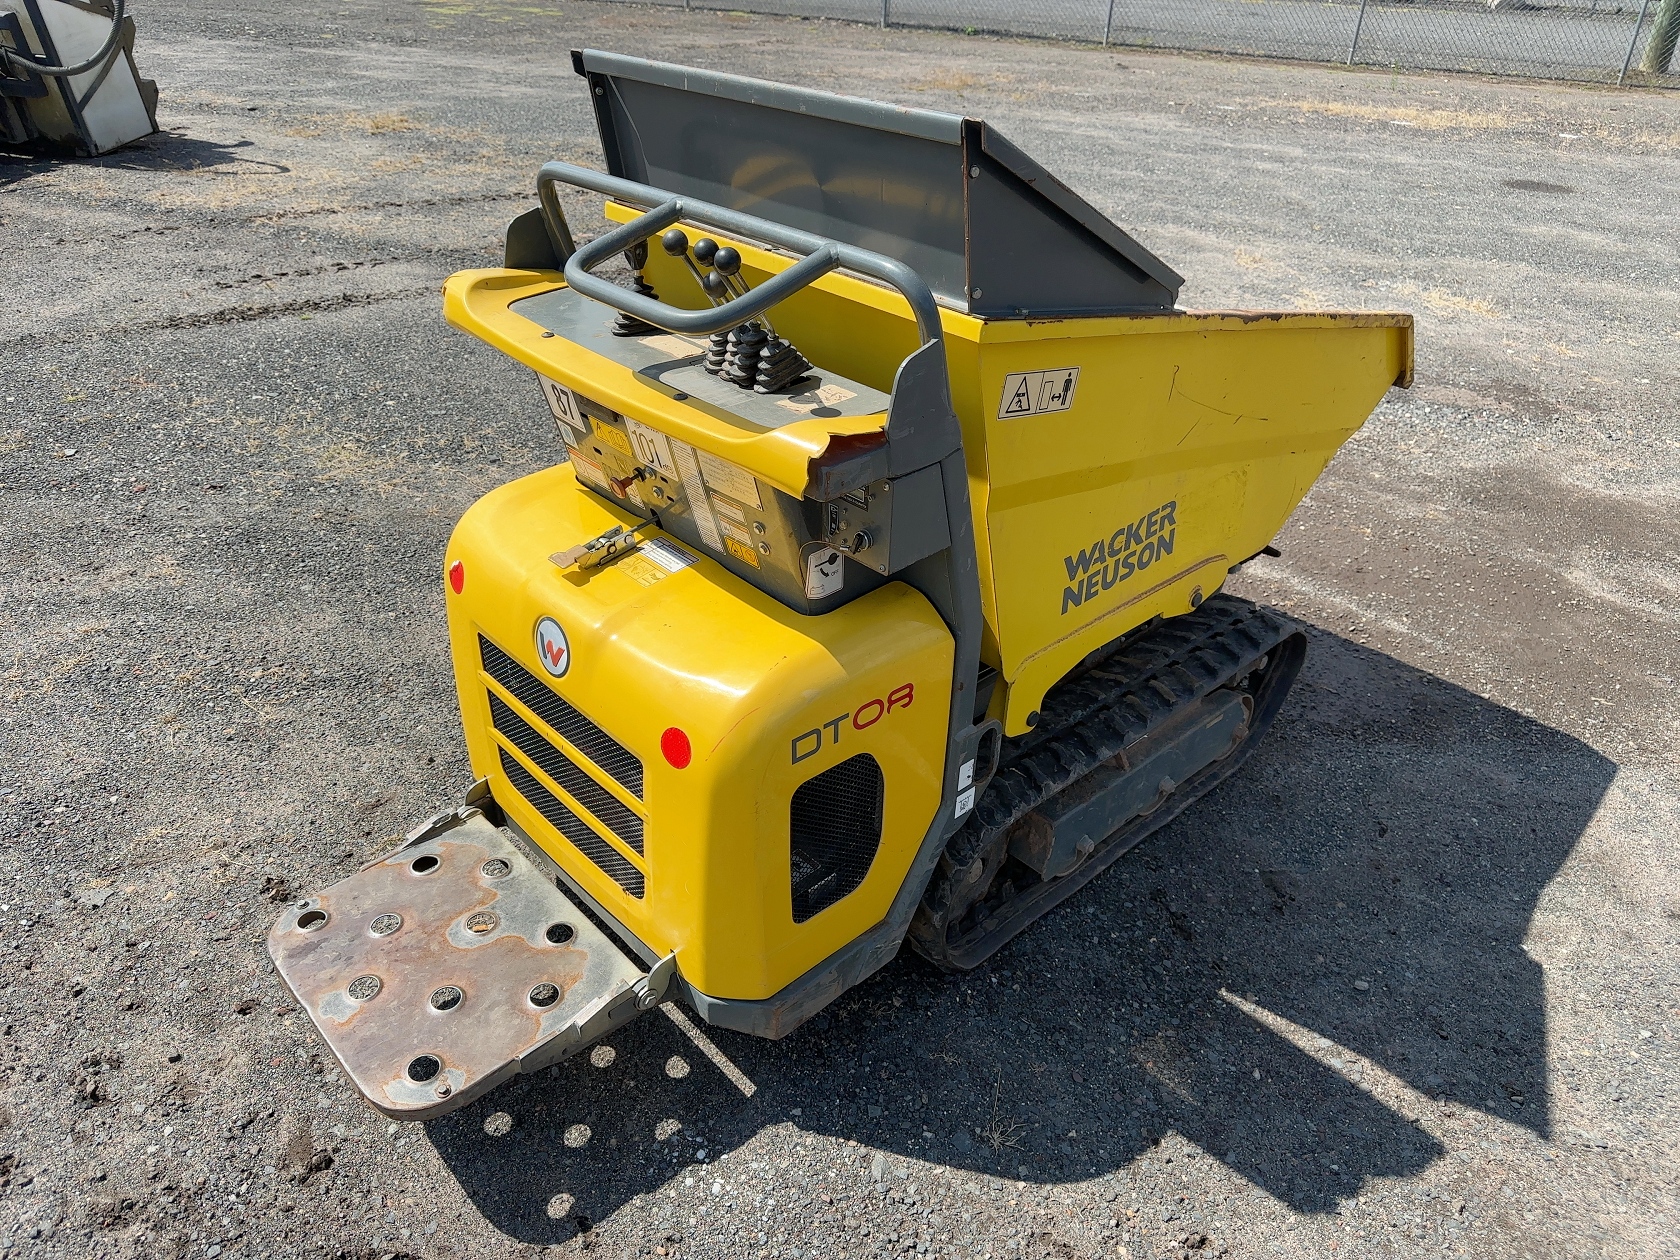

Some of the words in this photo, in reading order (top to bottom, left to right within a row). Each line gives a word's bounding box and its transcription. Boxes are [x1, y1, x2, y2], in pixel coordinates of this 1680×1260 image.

[551, 383, 575, 421] 87
[631, 429, 664, 469] 101
[1061, 527, 1176, 616] NEUSON
[1063, 500, 1177, 582] WACKER
[791, 682, 914, 765] DT08
